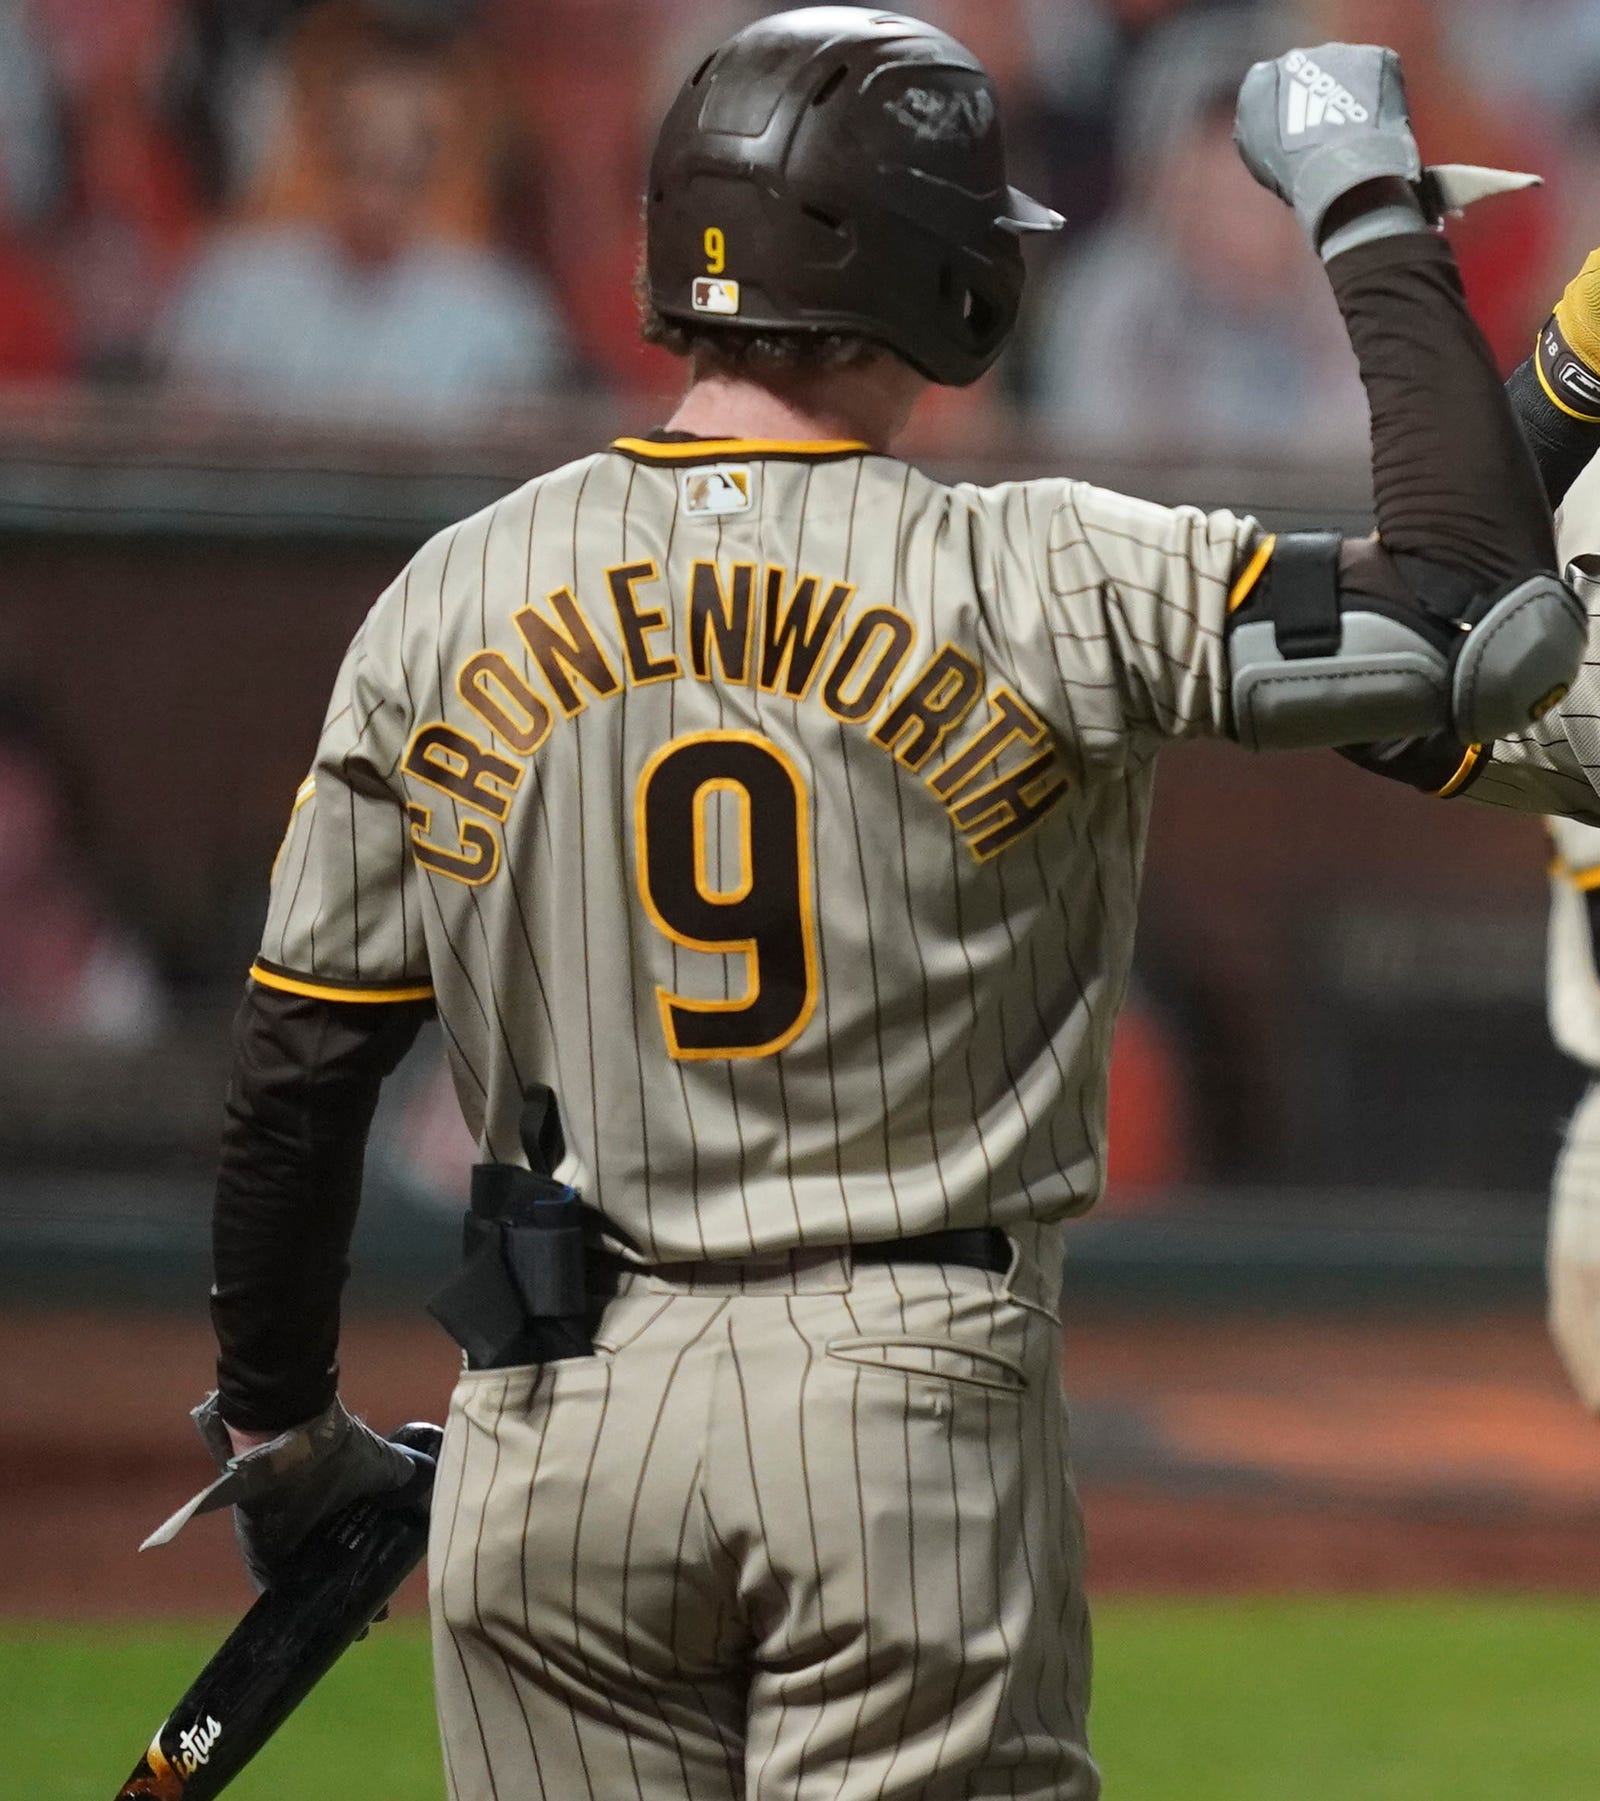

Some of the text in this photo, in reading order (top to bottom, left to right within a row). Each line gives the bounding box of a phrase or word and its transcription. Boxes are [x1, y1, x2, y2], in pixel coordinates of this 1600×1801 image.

[1285, 50, 1369, 123] adidas
[704, 226, 725, 275] 9
[1544, 331, 1559, 357] 18
[400, 558, 1071, 887] CRONENWORTH
[634, 729, 818, 1060] 9
